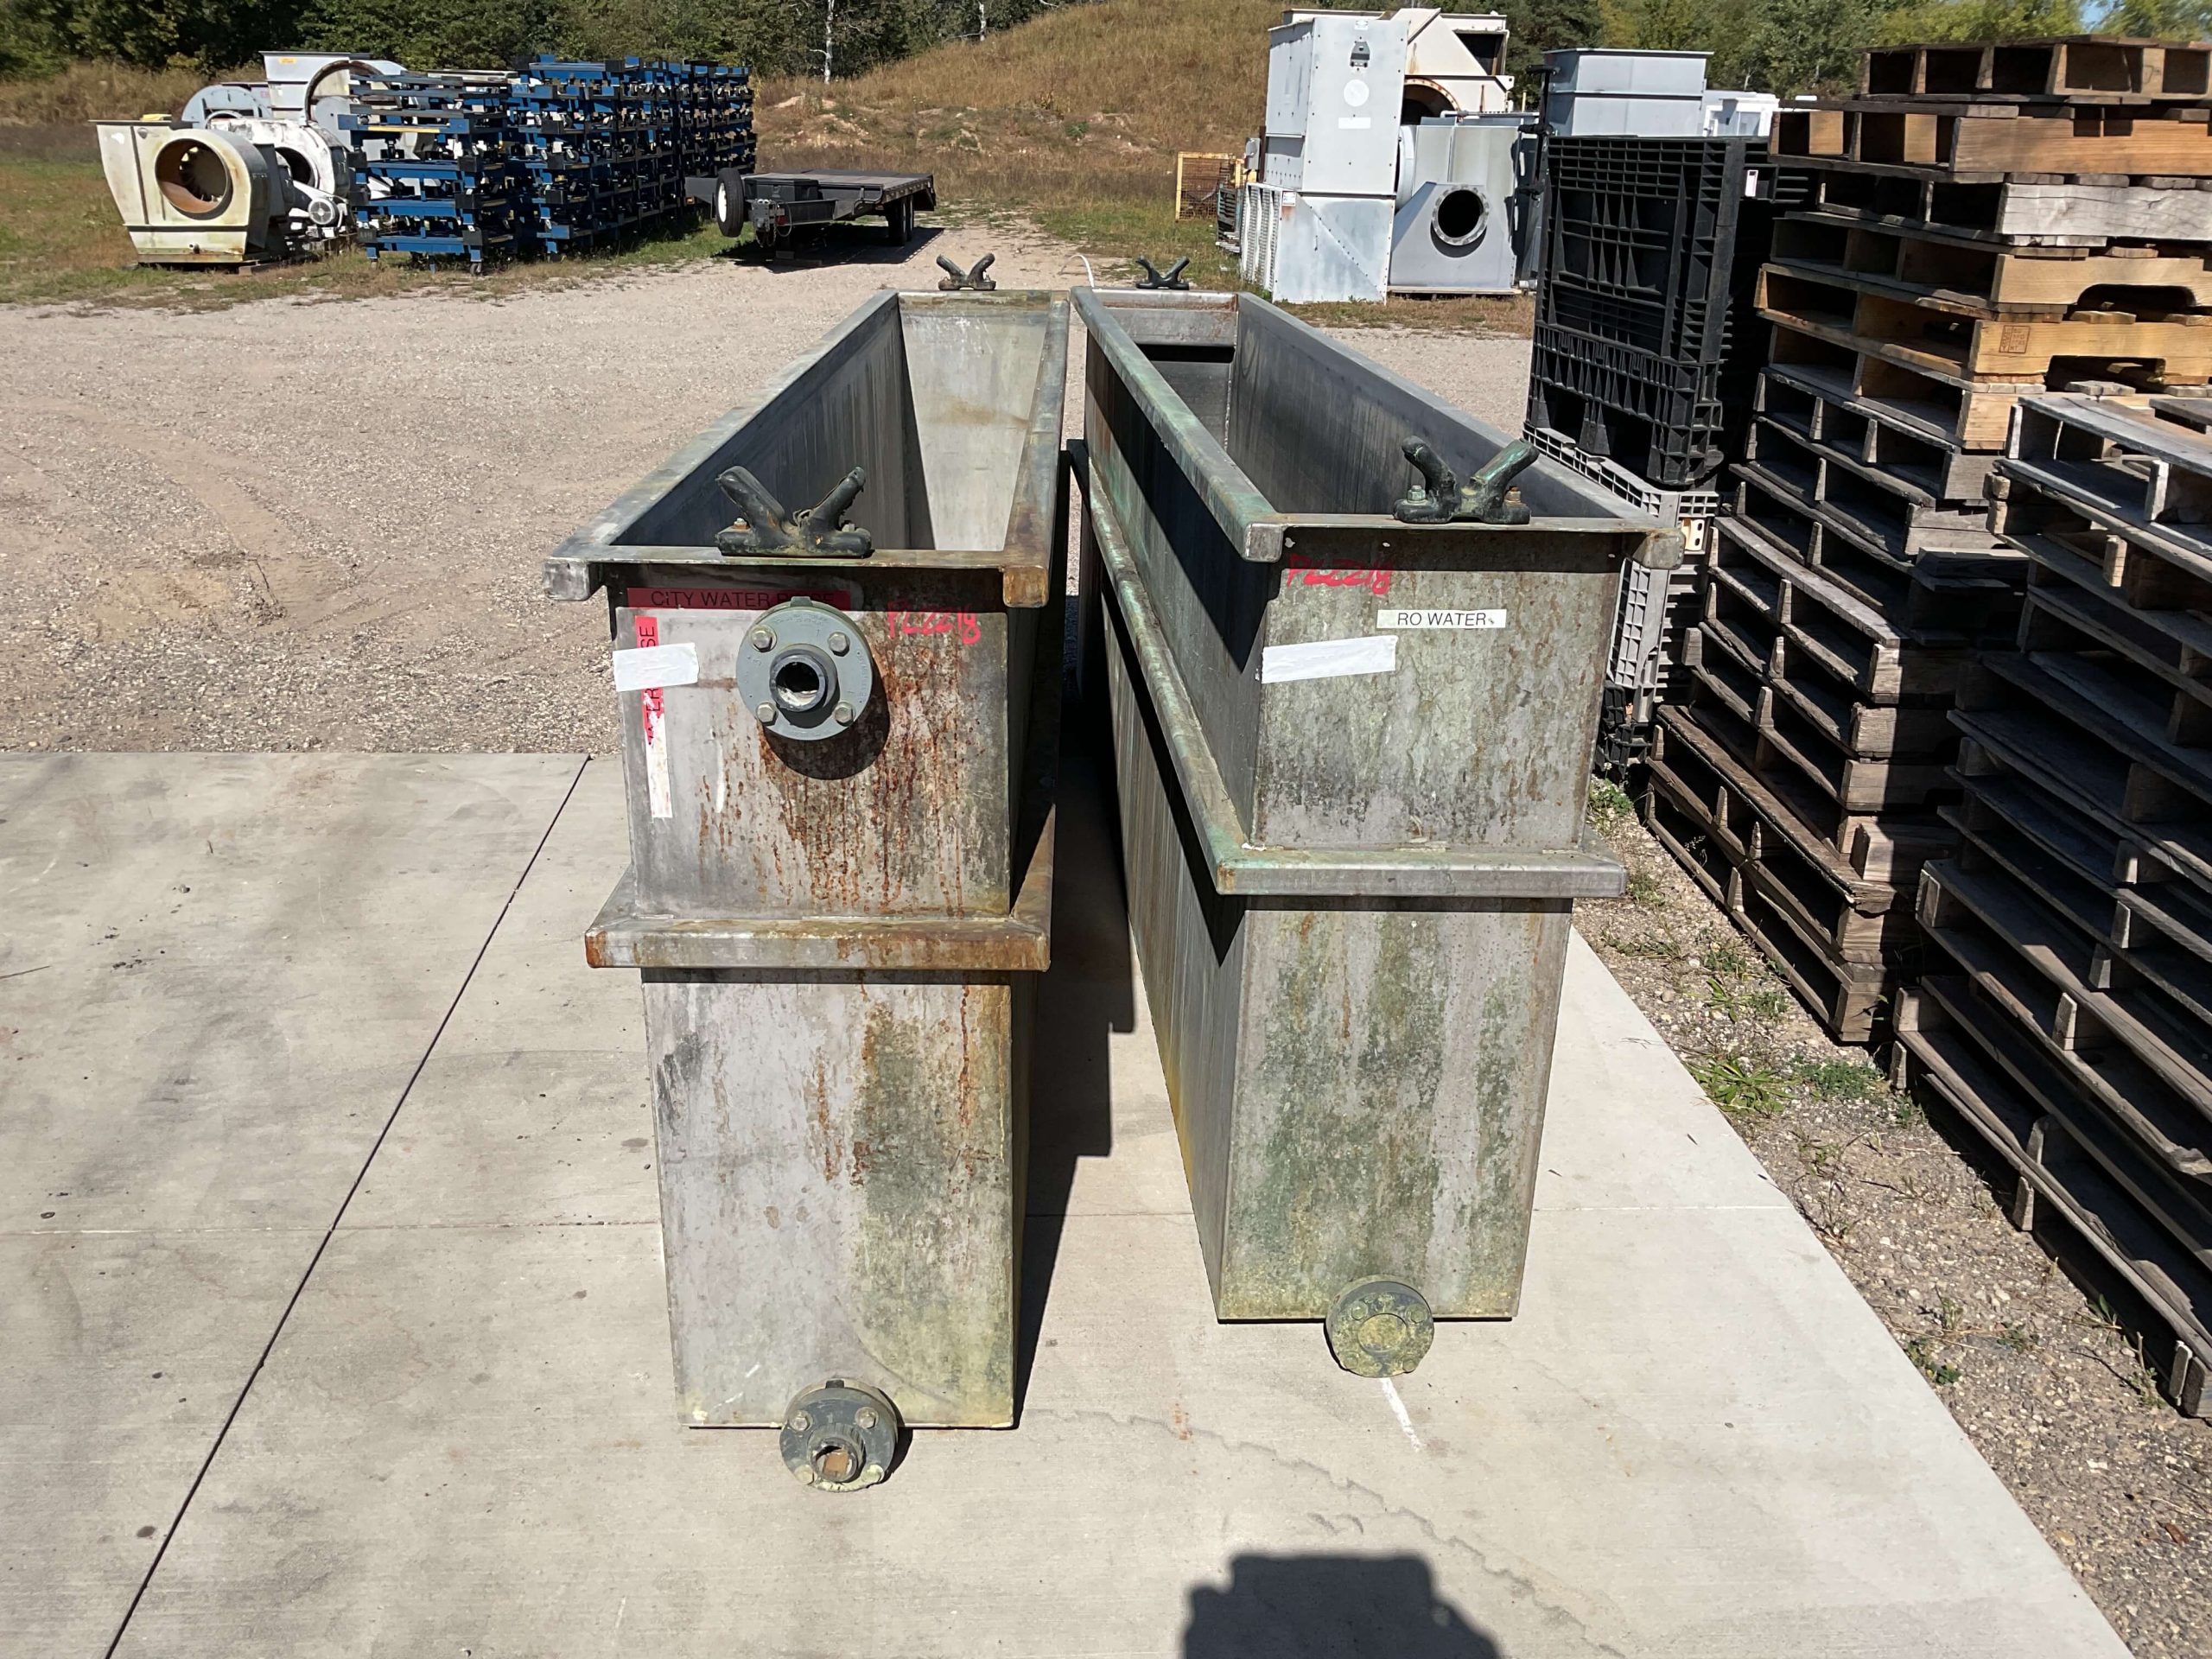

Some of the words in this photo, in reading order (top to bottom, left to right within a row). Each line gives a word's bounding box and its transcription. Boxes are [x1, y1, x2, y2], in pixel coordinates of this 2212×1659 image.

[651, 590, 695, 607] CITY
[700, 591, 770, 607] WATER
[1397, 612, 1422, 626] RO
[1427, 612, 1487, 626] WATER
